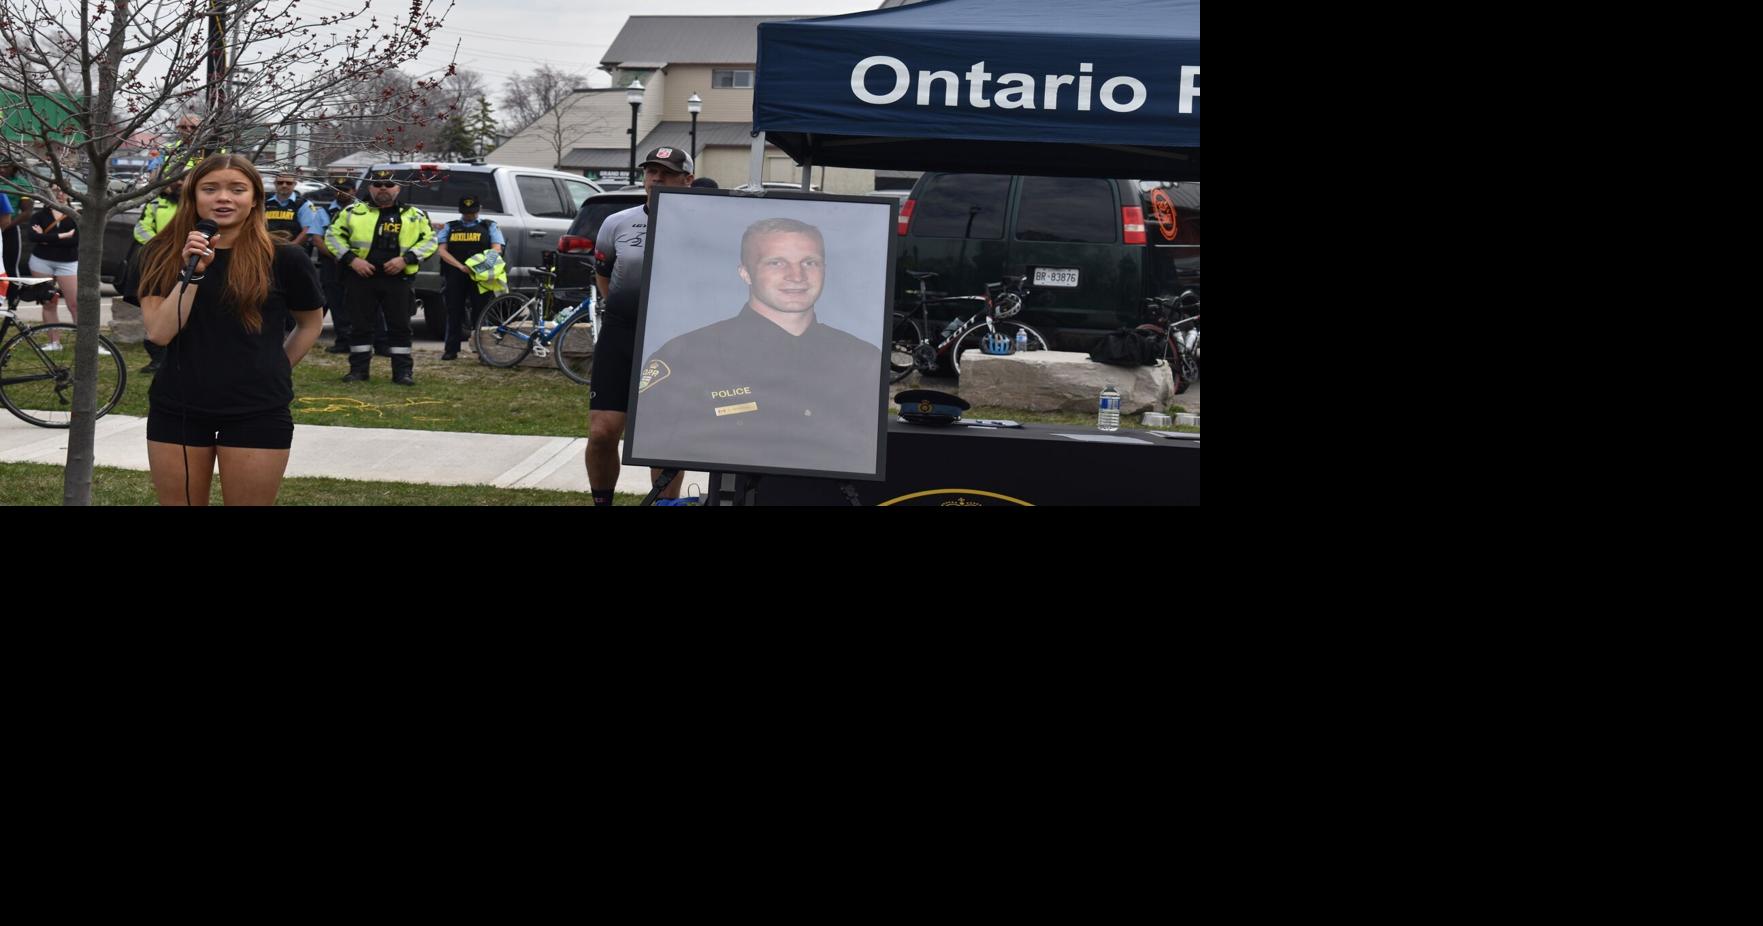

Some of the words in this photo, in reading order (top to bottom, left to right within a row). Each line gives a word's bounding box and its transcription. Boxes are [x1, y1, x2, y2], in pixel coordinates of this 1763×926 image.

[850, 55, 1148, 113] Ontario
[450, 231, 482, 242] AUXILIARY
[711, 386, 752, 399] POLICE
